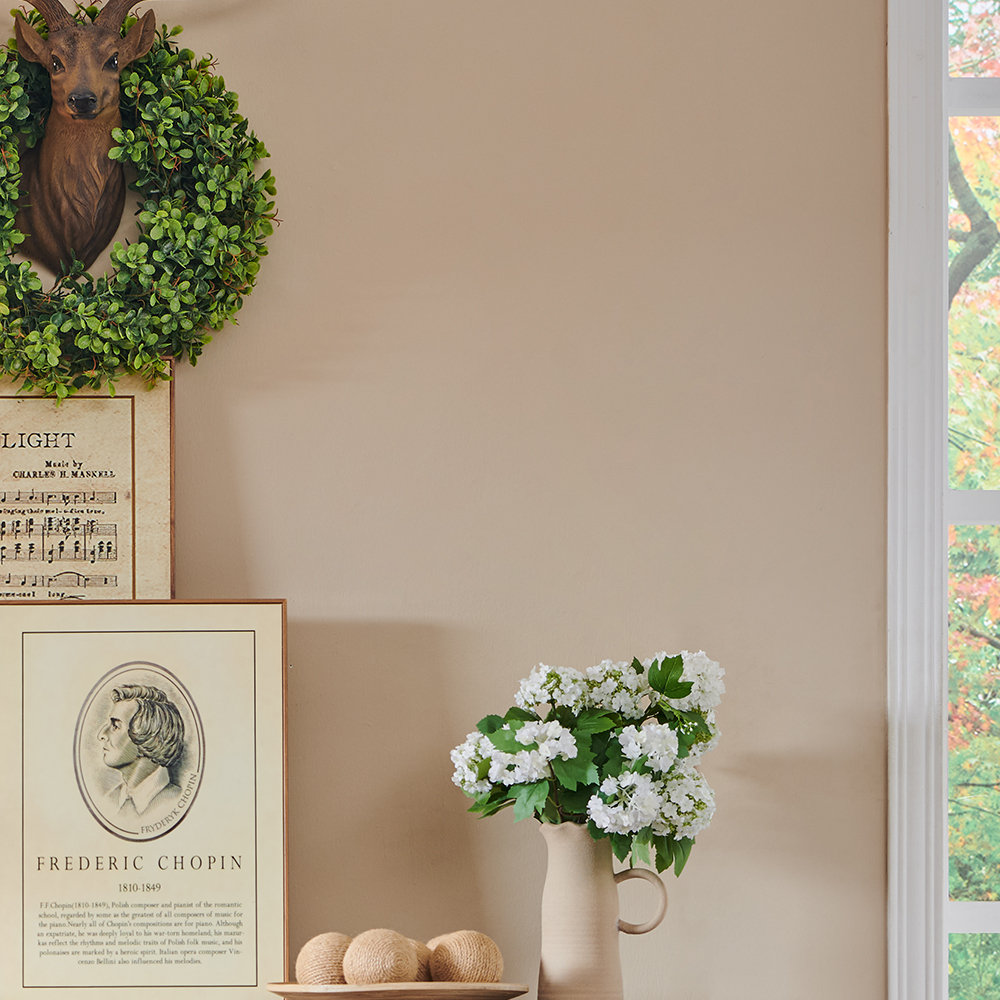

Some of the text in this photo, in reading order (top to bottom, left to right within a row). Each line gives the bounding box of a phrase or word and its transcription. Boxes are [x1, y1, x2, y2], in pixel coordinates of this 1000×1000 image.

[73, 460, 83, 470] by
[140, 773, 198, 835] FRYDERYK CHOPIN
[38, 856, 241, 870] FREDERIC CHOPIN
[119, 883, 161, 892] 1810-1849
[88, 912, 94, 920] by
[216, 920, 243, 929] Although
[106, 949, 113, 957] by
